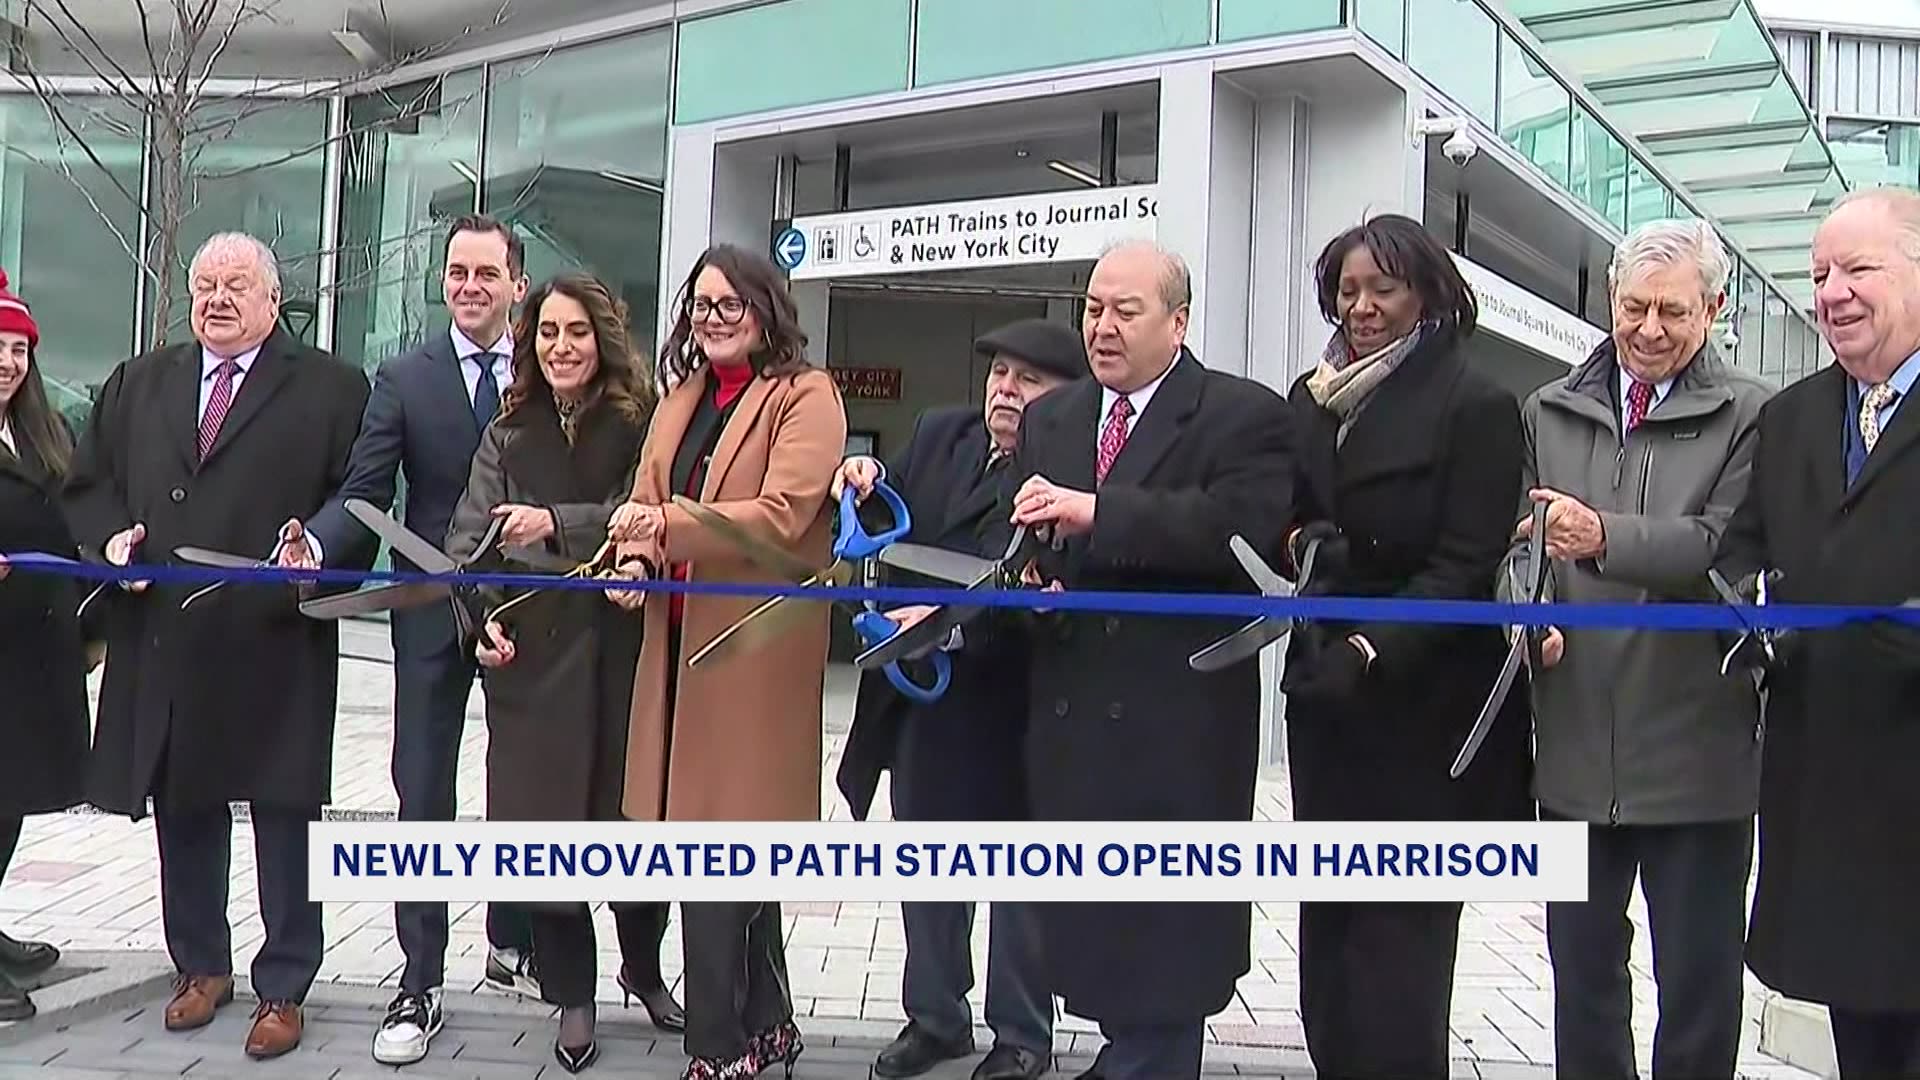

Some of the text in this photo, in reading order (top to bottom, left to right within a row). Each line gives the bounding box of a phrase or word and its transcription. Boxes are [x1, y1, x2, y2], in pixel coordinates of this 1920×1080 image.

[891, 214, 939, 238] PATH
[947, 210, 1008, 233] Trains
[1015, 208, 1037, 228] to
[1045, 196, 1128, 225] Journal
[890, 232, 1059, 264] & New York City
[866, 371, 897, 383] CITY
[855, 384, 890, 397] YORK
